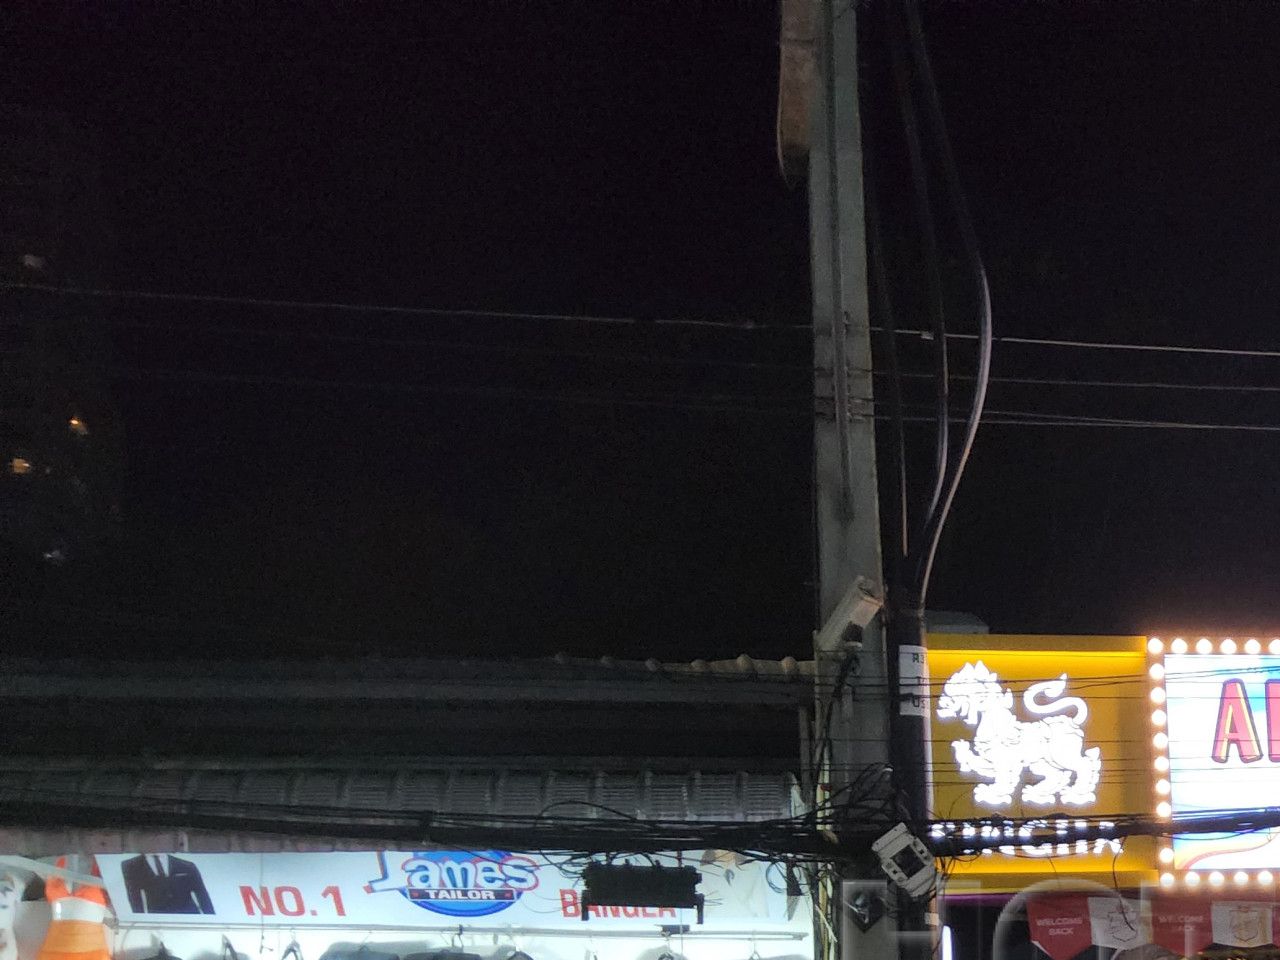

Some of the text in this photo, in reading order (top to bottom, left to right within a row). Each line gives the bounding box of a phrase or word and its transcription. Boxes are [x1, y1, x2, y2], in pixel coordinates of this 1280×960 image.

[363, 850, 541, 893] James
[239, 885, 347, 917] NO.1
[426, 889, 496, 901] TAILOR
[1036, 917, 1083, 926] WELCOME
[1048, 926, 1075, 936] BACK
